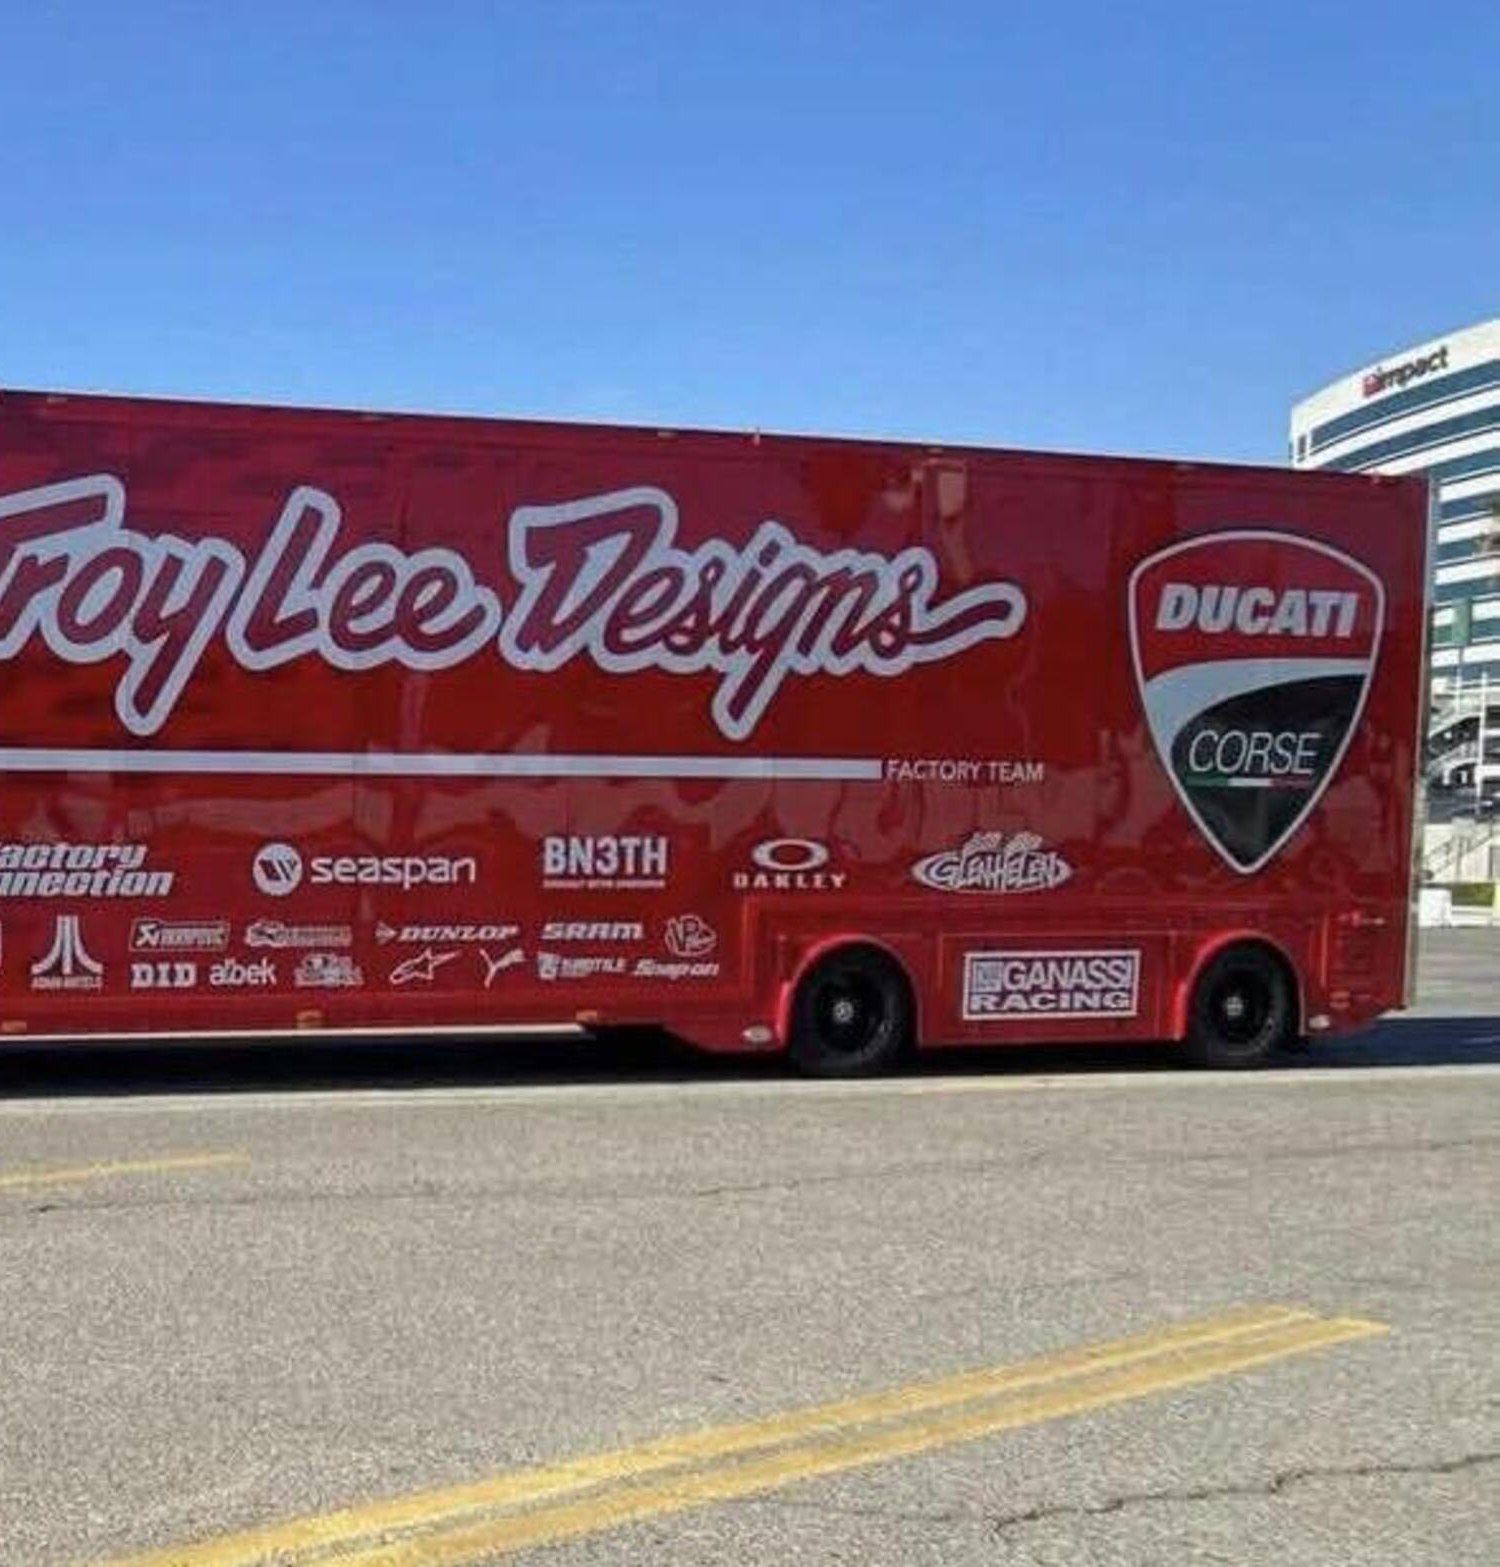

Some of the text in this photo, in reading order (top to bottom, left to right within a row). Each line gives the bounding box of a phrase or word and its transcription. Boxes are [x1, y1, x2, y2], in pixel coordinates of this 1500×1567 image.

[227, 485, 502, 671] Lee
[500, 486, 1027, 741] Designs
[1155, 583, 1358, 638] DUCATI
[1188, 730, 1320, 776] CORSE
[886, 759, 1045, 783] FACTORY TEAM
[543, 836, 667, 875] BN3TH
[311, 856, 477, 890] seaspan
[733, 872, 846, 889] OAKLEY
[399, 925, 519, 943] DUNLOP
[542, 922, 644, 940] SRAM
[1002, 959, 1133, 991] GANASSI
[970, 991, 1131, 1012] RACING
